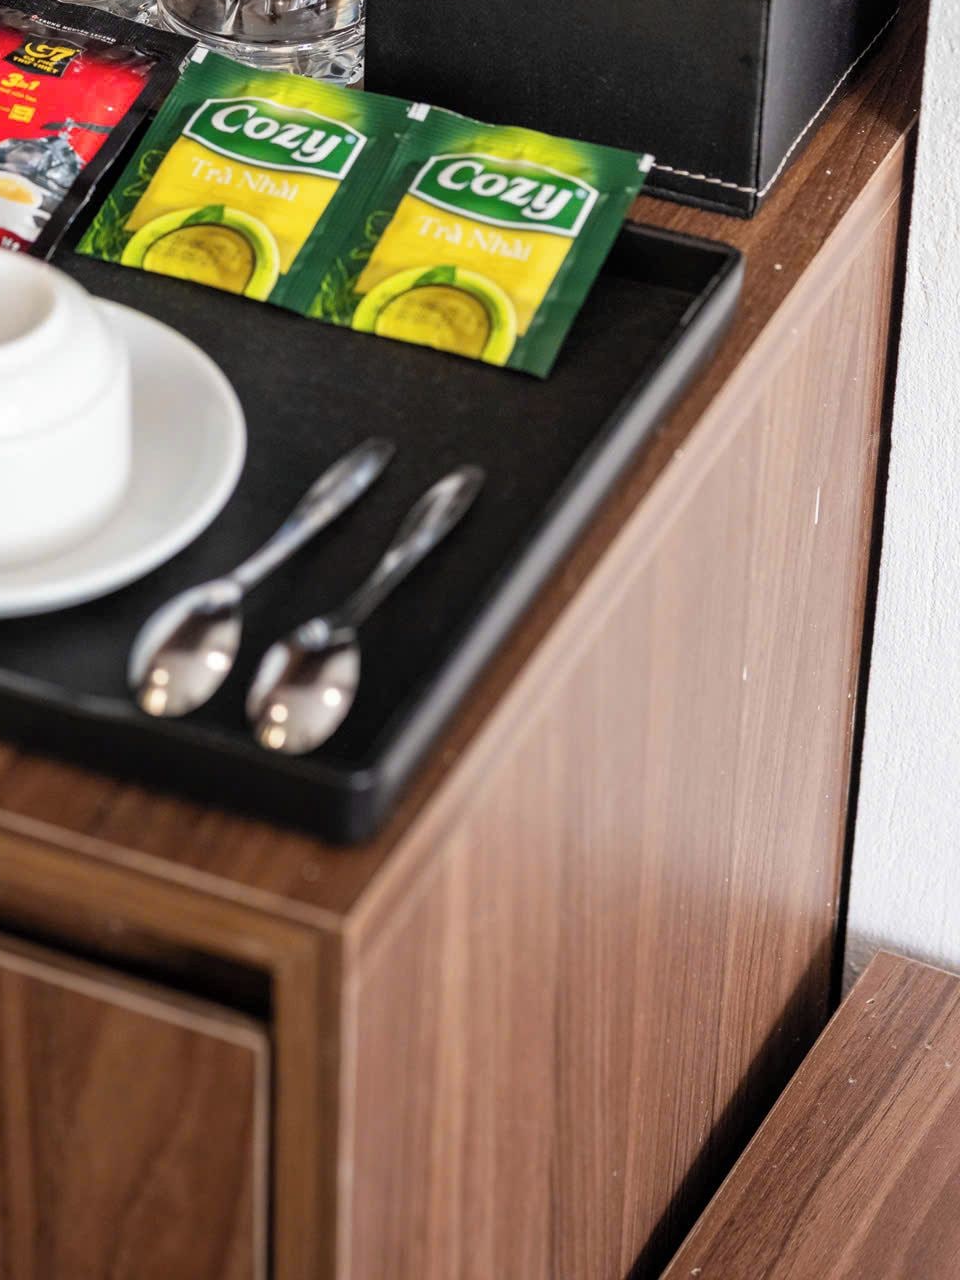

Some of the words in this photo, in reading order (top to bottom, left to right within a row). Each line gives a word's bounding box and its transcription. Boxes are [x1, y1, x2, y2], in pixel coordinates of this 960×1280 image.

[211, 104, 342, 163] Cozy
[192, 157, 233, 186] Trà
[437, 160, 573, 221] Cozy
